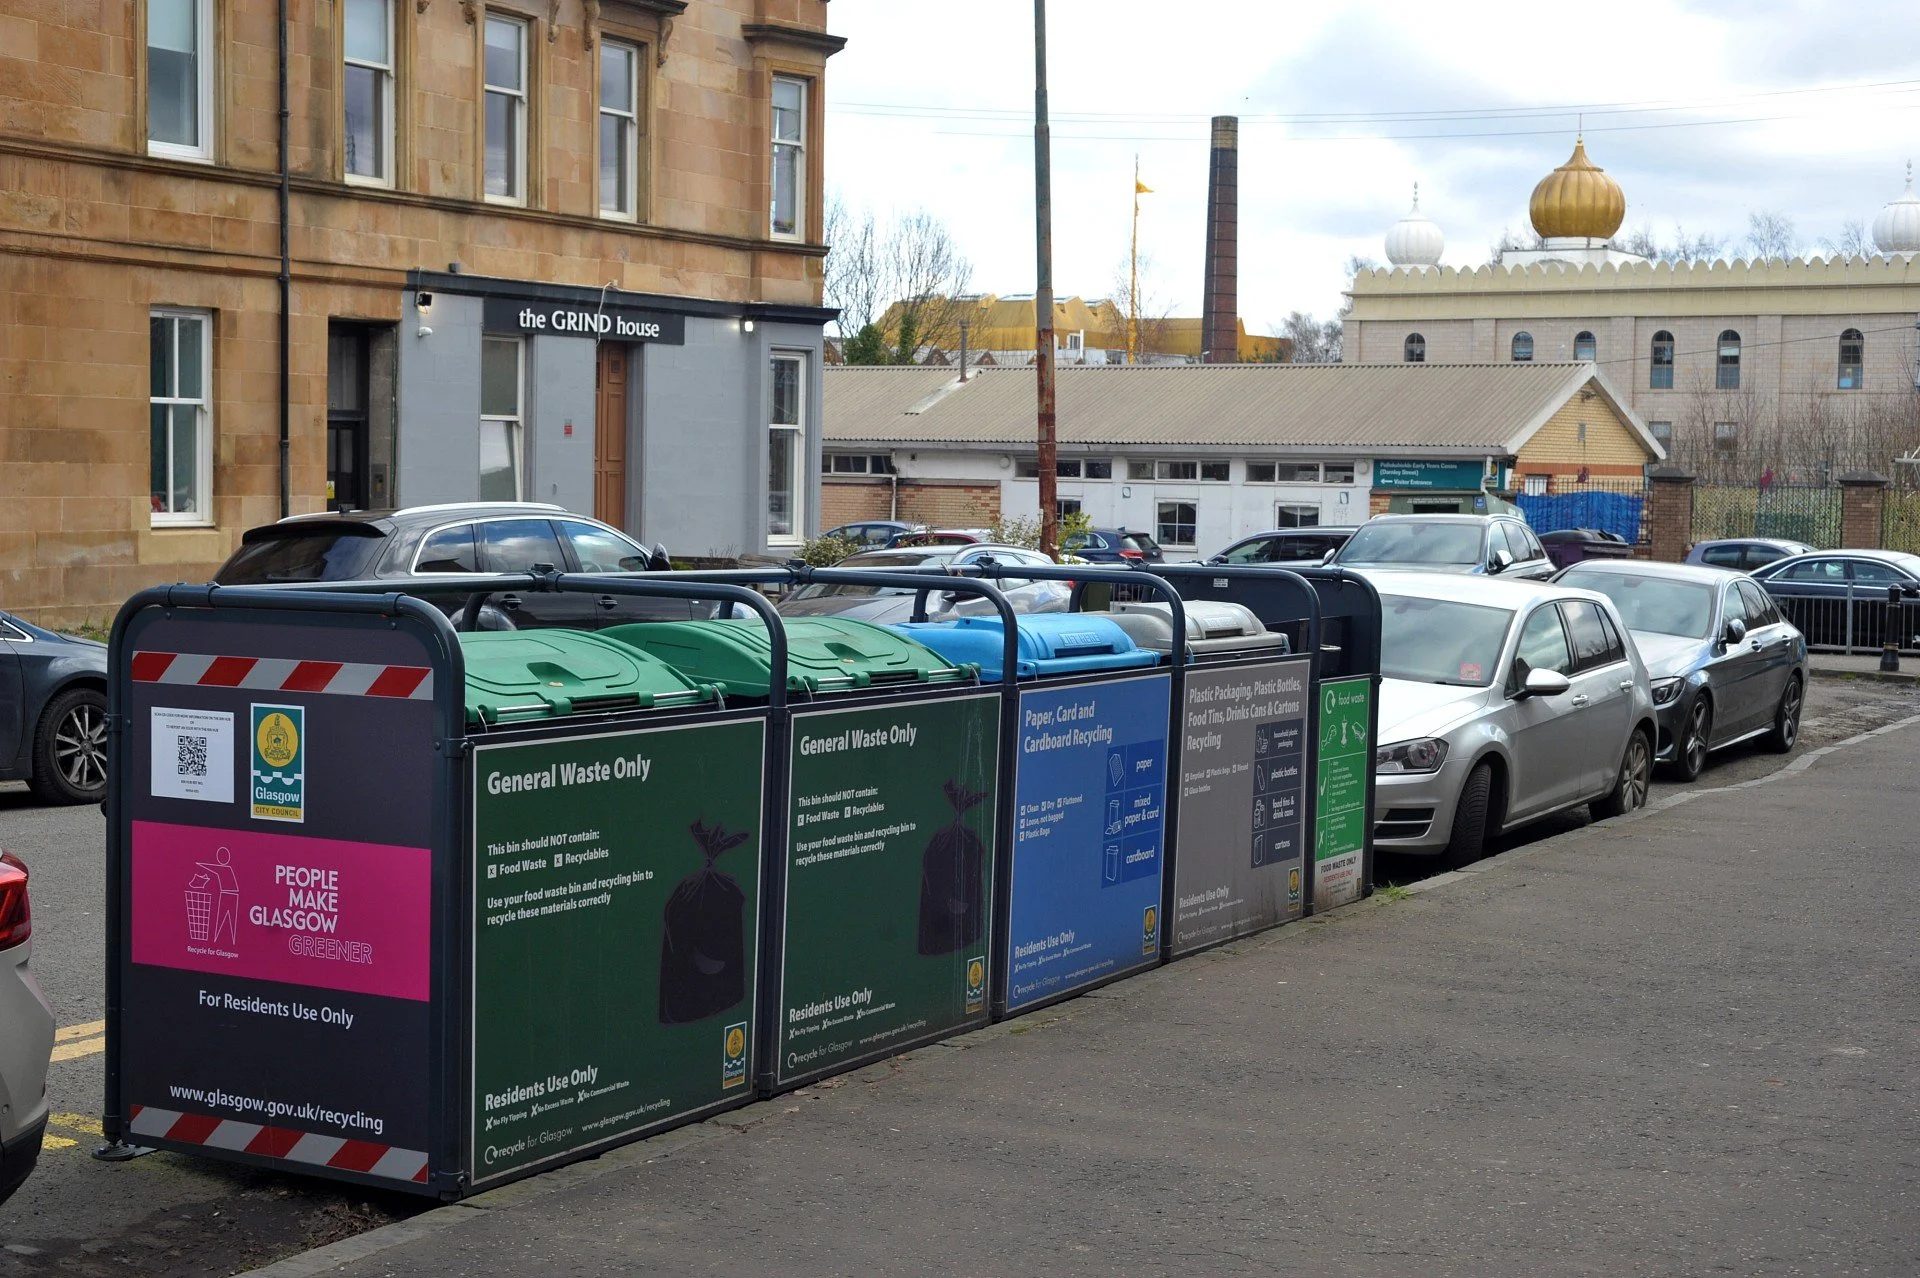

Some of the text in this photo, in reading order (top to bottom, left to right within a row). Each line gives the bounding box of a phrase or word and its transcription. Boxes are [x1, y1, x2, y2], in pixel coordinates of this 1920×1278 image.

[519, 308, 660, 337] the GRIND house
[1189, 677, 1302, 704] Plastic Packaging, Plastic Bottles,
[1339, 691, 1364, 705] food waste
[1025, 700, 1095, 731] Paper, Card and
[1188, 701, 1300, 727] Food Tins, Drinks Cans & Cartons
[800, 723, 917, 756] General Waste Only
[1024, 725, 1113, 754] Cardboard Recycling
[1187, 731, 1222, 752] Recycling
[487, 754, 651, 795] General Waste Only
[1135, 757, 1153, 772] paper
[1271, 765, 1298, 781] plastic bottles
[255, 786, 300, 804] Glasgow
[798, 787, 878, 807] This bin should NOT contain:
[1047, 801, 1055, 810] Dry
[1134, 793, 1151, 808] mixed
[1272, 796, 1283, 809] food
[1290, 795, 1295, 805] &
[255, 806, 299, 816] CITY COUNCIL
[805, 803, 885, 823] Food Waste Recyclables
[1124, 807, 1159, 825] paper & card
[1273, 808, 1294, 820] drink cans
[487, 829, 600, 856] This bin should NOT contain:
[796, 822, 916, 852] Use your food waste bin and recycling bin to
[1275, 839, 1290, 850] cartons
[499, 848, 609, 876] Food Waste Recyclables
[796, 840, 885, 866] recycle these materials correctly
[1125, 846, 1155, 865] cardboard
[1321, 856, 1356, 873] FOOD WASTE ONLY
[275, 865, 339, 890] PEOPLE
[487, 869, 654, 909] Use your food waste bin and recycling bin to
[289, 888, 338, 912] MAKE
[487, 892, 611, 926] recycle these materials correctly
[1180, 894, 1205, 908] Residents
[1206, 890, 1216, 901] Use
[1216, 885, 1229, 899] Only
[250, 905, 338, 933] GLASGOW
[187, 945, 239, 959] Recycle for Glasgow
[289, 934, 372, 965] GREENER
[1014, 939, 1046, 959] Residents
[1047, 936, 1059, 948] Use
[1060, 930, 1075, 944] Only
[199, 990, 353, 1030] For Residents Use Only
[789, 999, 833, 1023] Residents
[834, 995, 851, 1010] Use
[852, 987, 872, 1005] Only
[796, 1050, 817, 1062] recycle
[828, 1040, 853, 1053] Glasgow
[485, 1065, 598, 1112] Residents Use Only
[169, 1085, 383, 1135] www.glasgow.gov.uk/recycling
[493, 1119, 500, 1127] No
[500, 1116, 508, 1124] Fly
[508, 1111, 527, 1122] Tipping
[537, 1105, 544, 1113] No
[544, 1101, 559, 1111] Excess
[560, 1097, 574, 1105] Waste
[590, 1084, 616, 1097] Commercial
[616, 1080, 630, 1089] Waste
[498, 1098, 670, 1157] recycle for Glasgow www.glasgow.gov.uk/recycling
